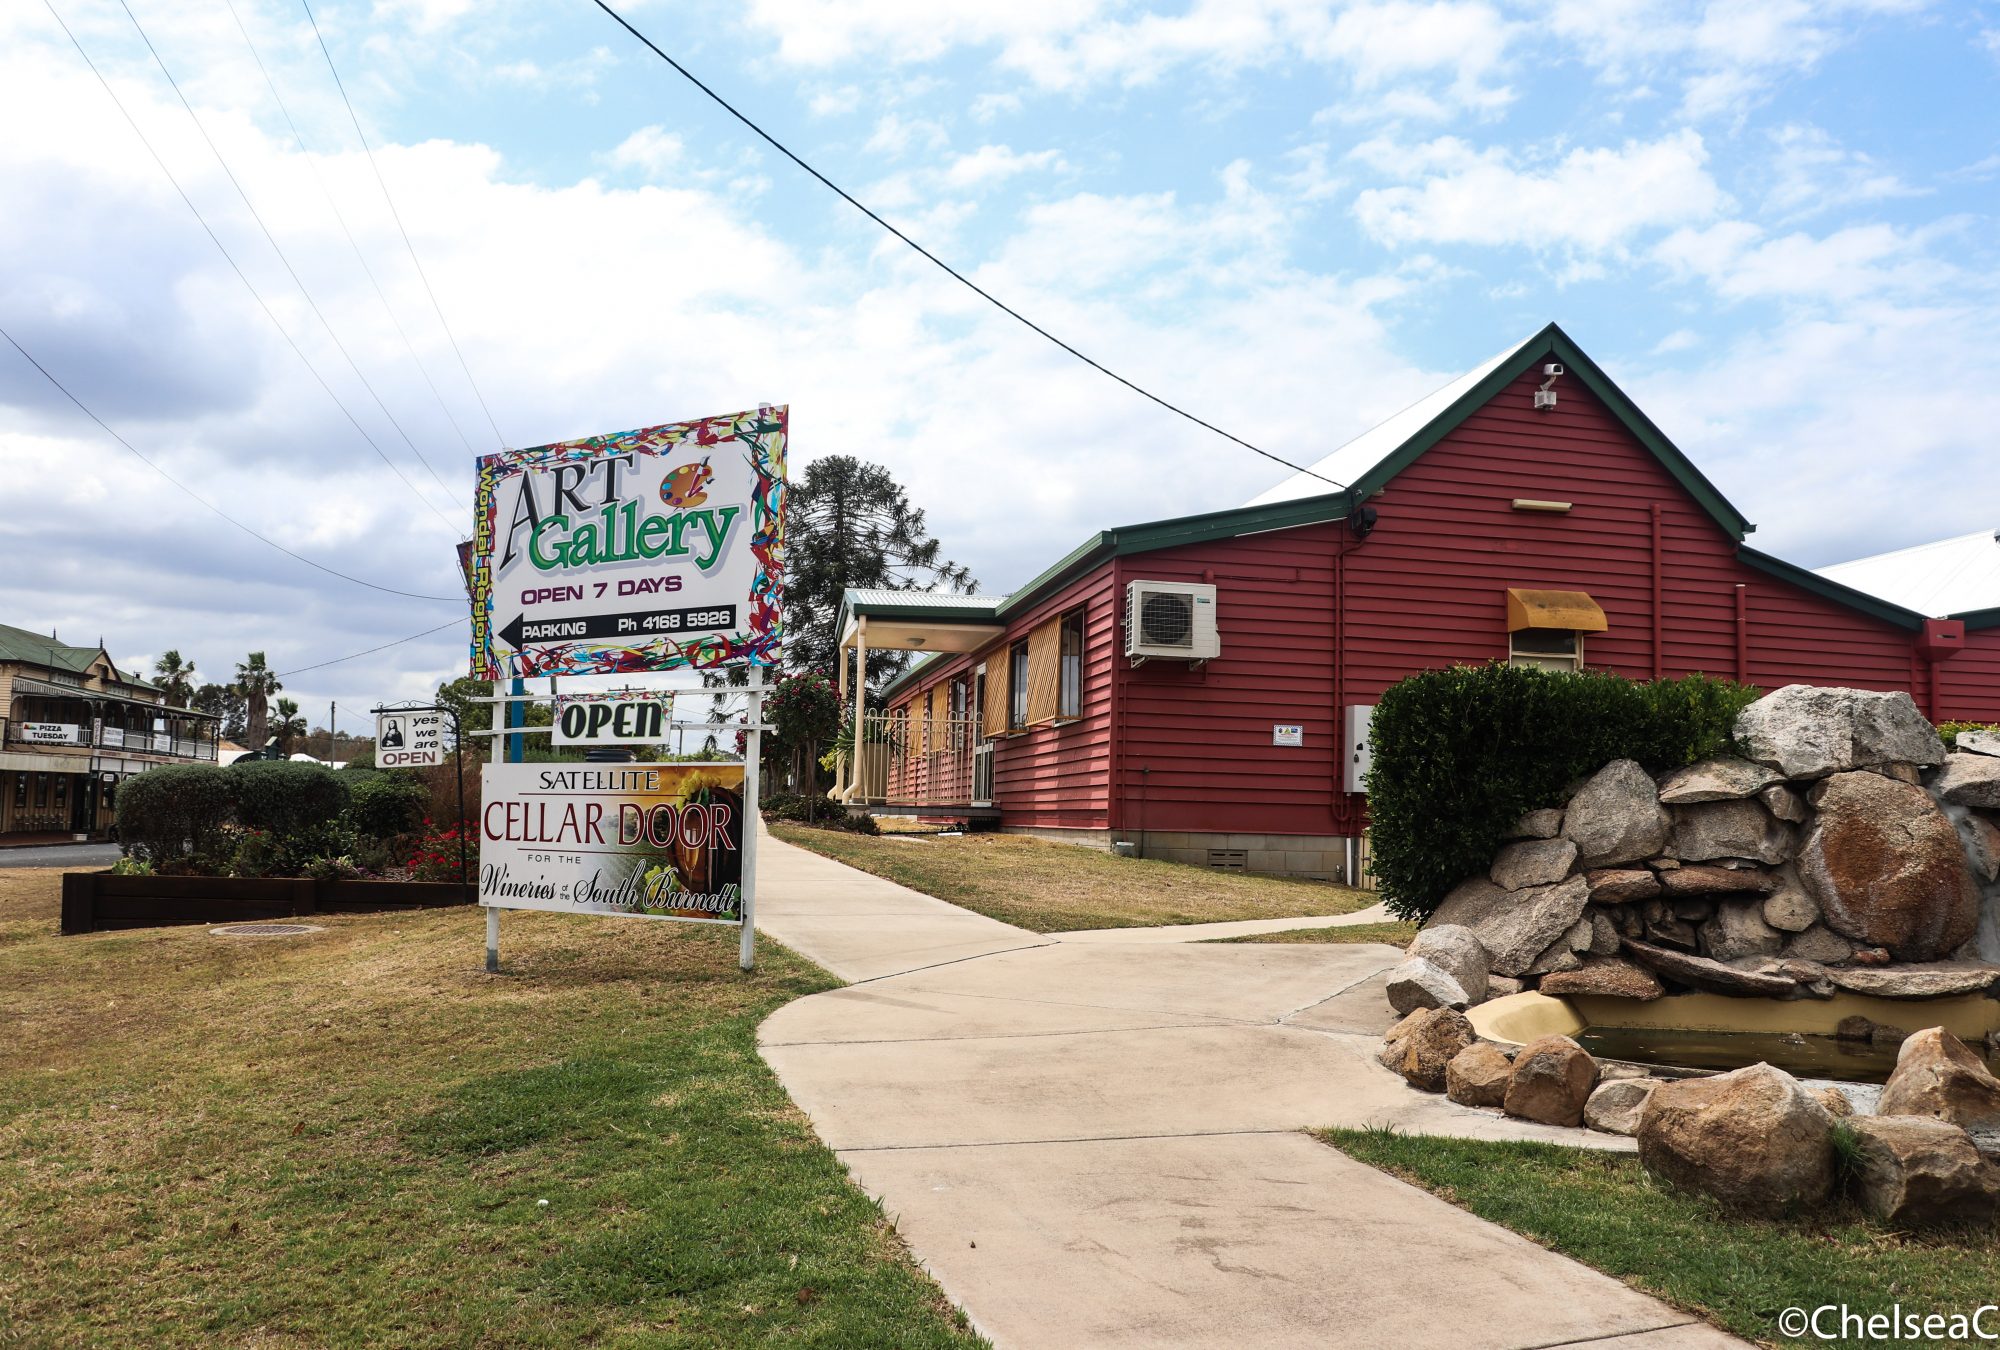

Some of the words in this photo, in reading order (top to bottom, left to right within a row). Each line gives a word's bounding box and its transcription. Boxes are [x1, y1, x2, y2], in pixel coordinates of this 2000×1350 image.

[475, 464, 493, 557] Wondai
[499, 456, 633, 571] ART
[529, 500, 739, 571] Gallery
[521, 583, 583, 605] OPEN
[593, 582, 608, 599] 7
[618, 576, 682, 597] DAYS
[473, 566, 489, 674] Regional
[522, 621, 586, 639] PARKING
[618, 617, 637, 631] Ph
[643, 614, 680, 630] 4168
[687, 611, 731, 627] 5926
[412, 716, 439, 726] yes
[415, 729, 437, 738] we
[561, 702, 662, 739] OPEN
[32, 732, 68, 740] TUESDAY
[414, 740, 439, 749] are
[383, 751, 436, 765] OPEN
[539, 771, 659, 791] SATELLITE
[484, 801, 607, 845] CELLAR
[618, 802, 736, 851] DOOR
[528, 854, 551, 863] FOR
[559, 855, 582, 864] THE
[480, 863, 556, 900] Wineries
[572, 858, 646, 907] South
[643, 867, 737, 914] Burnett
